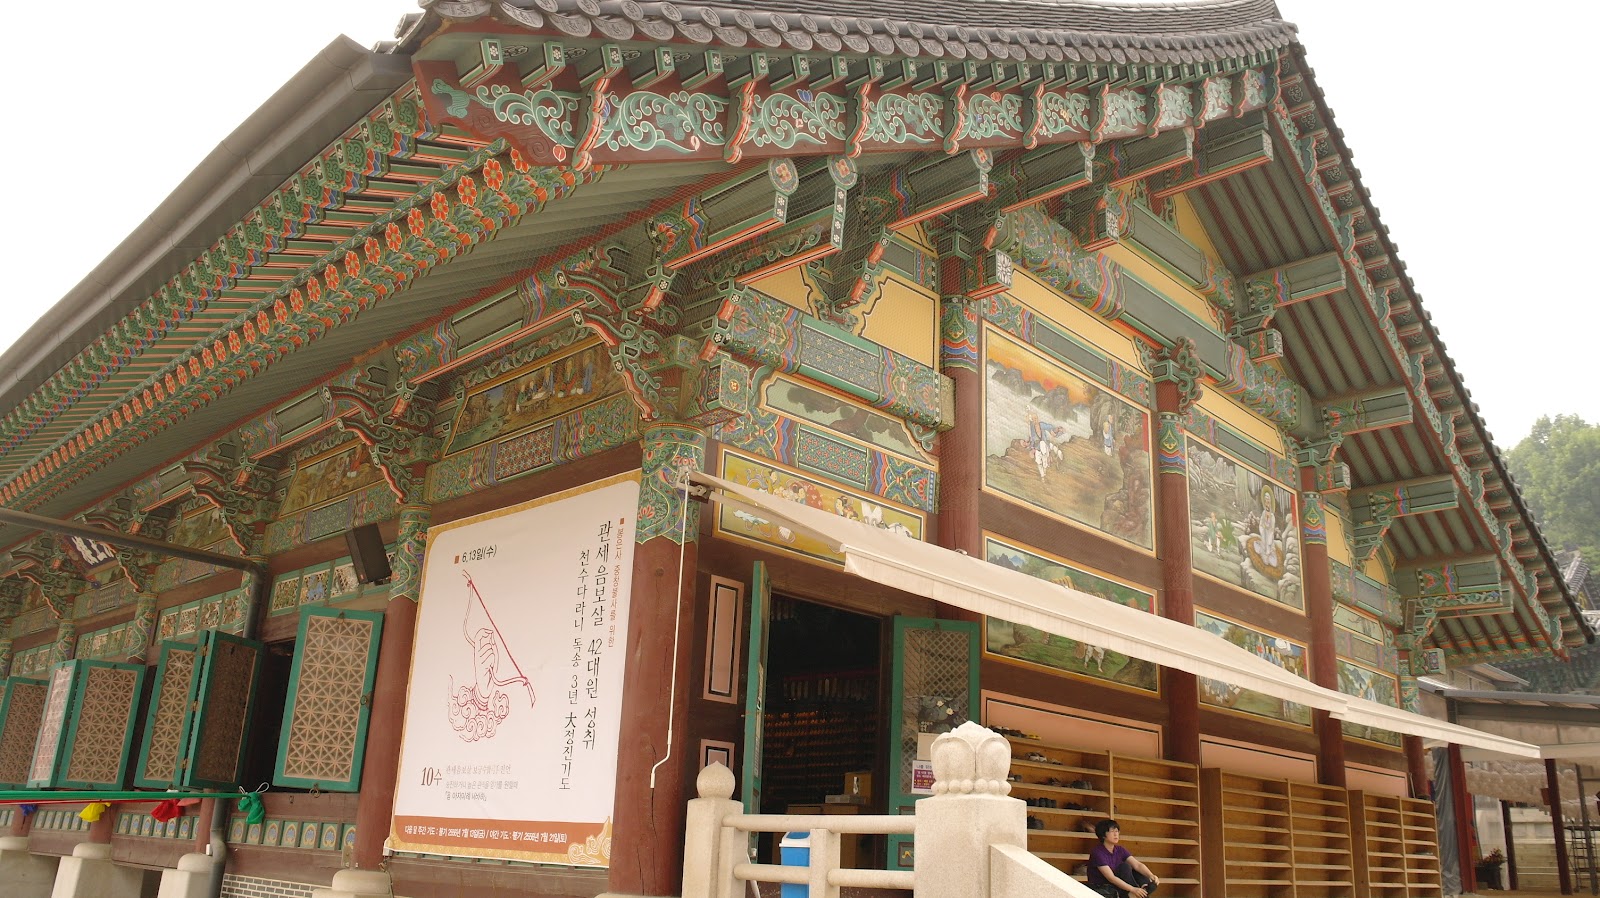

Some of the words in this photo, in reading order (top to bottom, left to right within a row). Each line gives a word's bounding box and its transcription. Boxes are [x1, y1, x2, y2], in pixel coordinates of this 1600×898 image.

[574, 549, 590, 632] 천수다라니
[591, 520, 613, 627] 관세음보살
[571, 637, 583, 668] 독송
[608, 624, 616, 648] 위한
[568, 674, 578, 705] 3년
[585, 637, 603, 698] 42대원
[582, 706, 598, 750] 성취
[558, 711, 577, 790] 大정진기도
[420, 766, 443, 787] 10수
